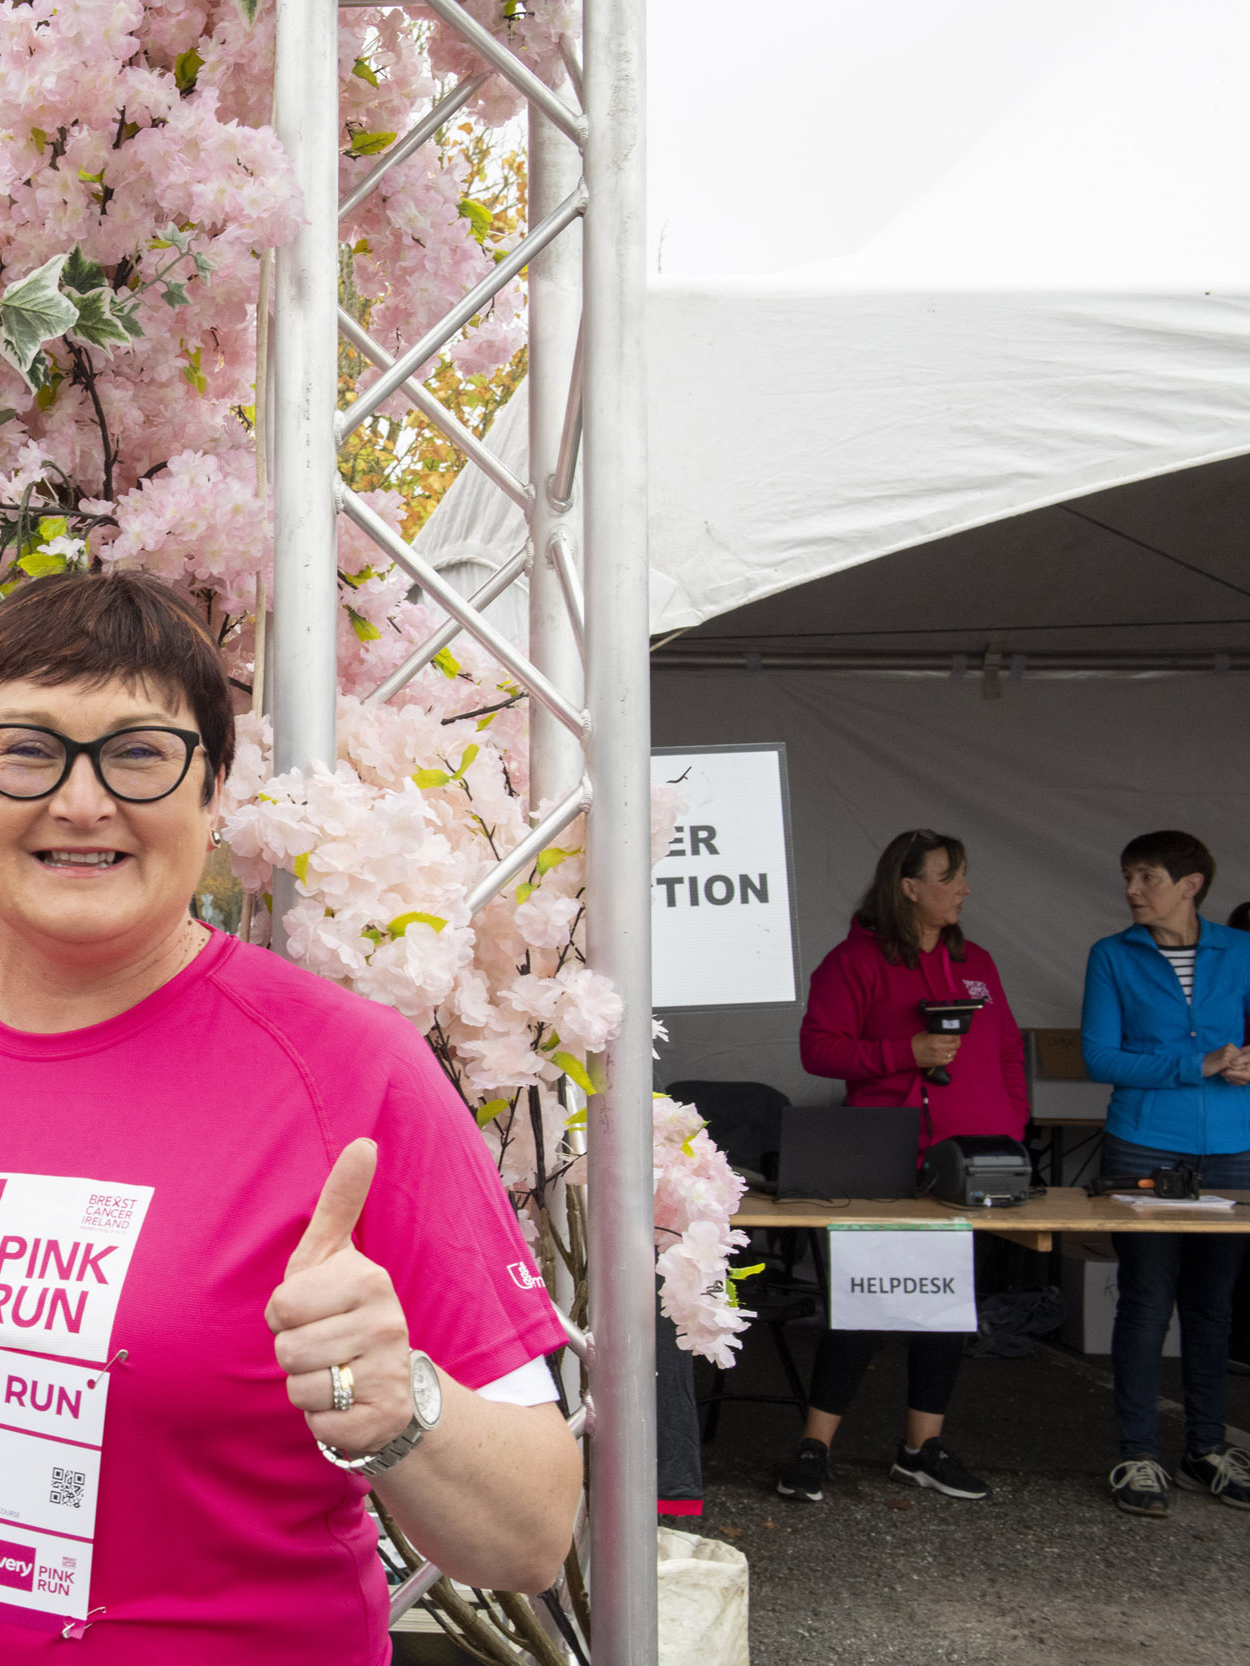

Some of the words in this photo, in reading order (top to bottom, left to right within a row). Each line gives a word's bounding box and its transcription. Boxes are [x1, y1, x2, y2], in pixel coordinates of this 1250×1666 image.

[652, 872, 769, 908] TION
[85, 1205, 133, 1220] CANCER
[81, 1215, 130, 1229] IRELAND
[850, 1277, 955, 1294] HELPDESK
[4, 1374, 82, 1420] RUN
[38, 1565, 75, 1584] PINK
[37, 1578, 70, 1596] RUN
